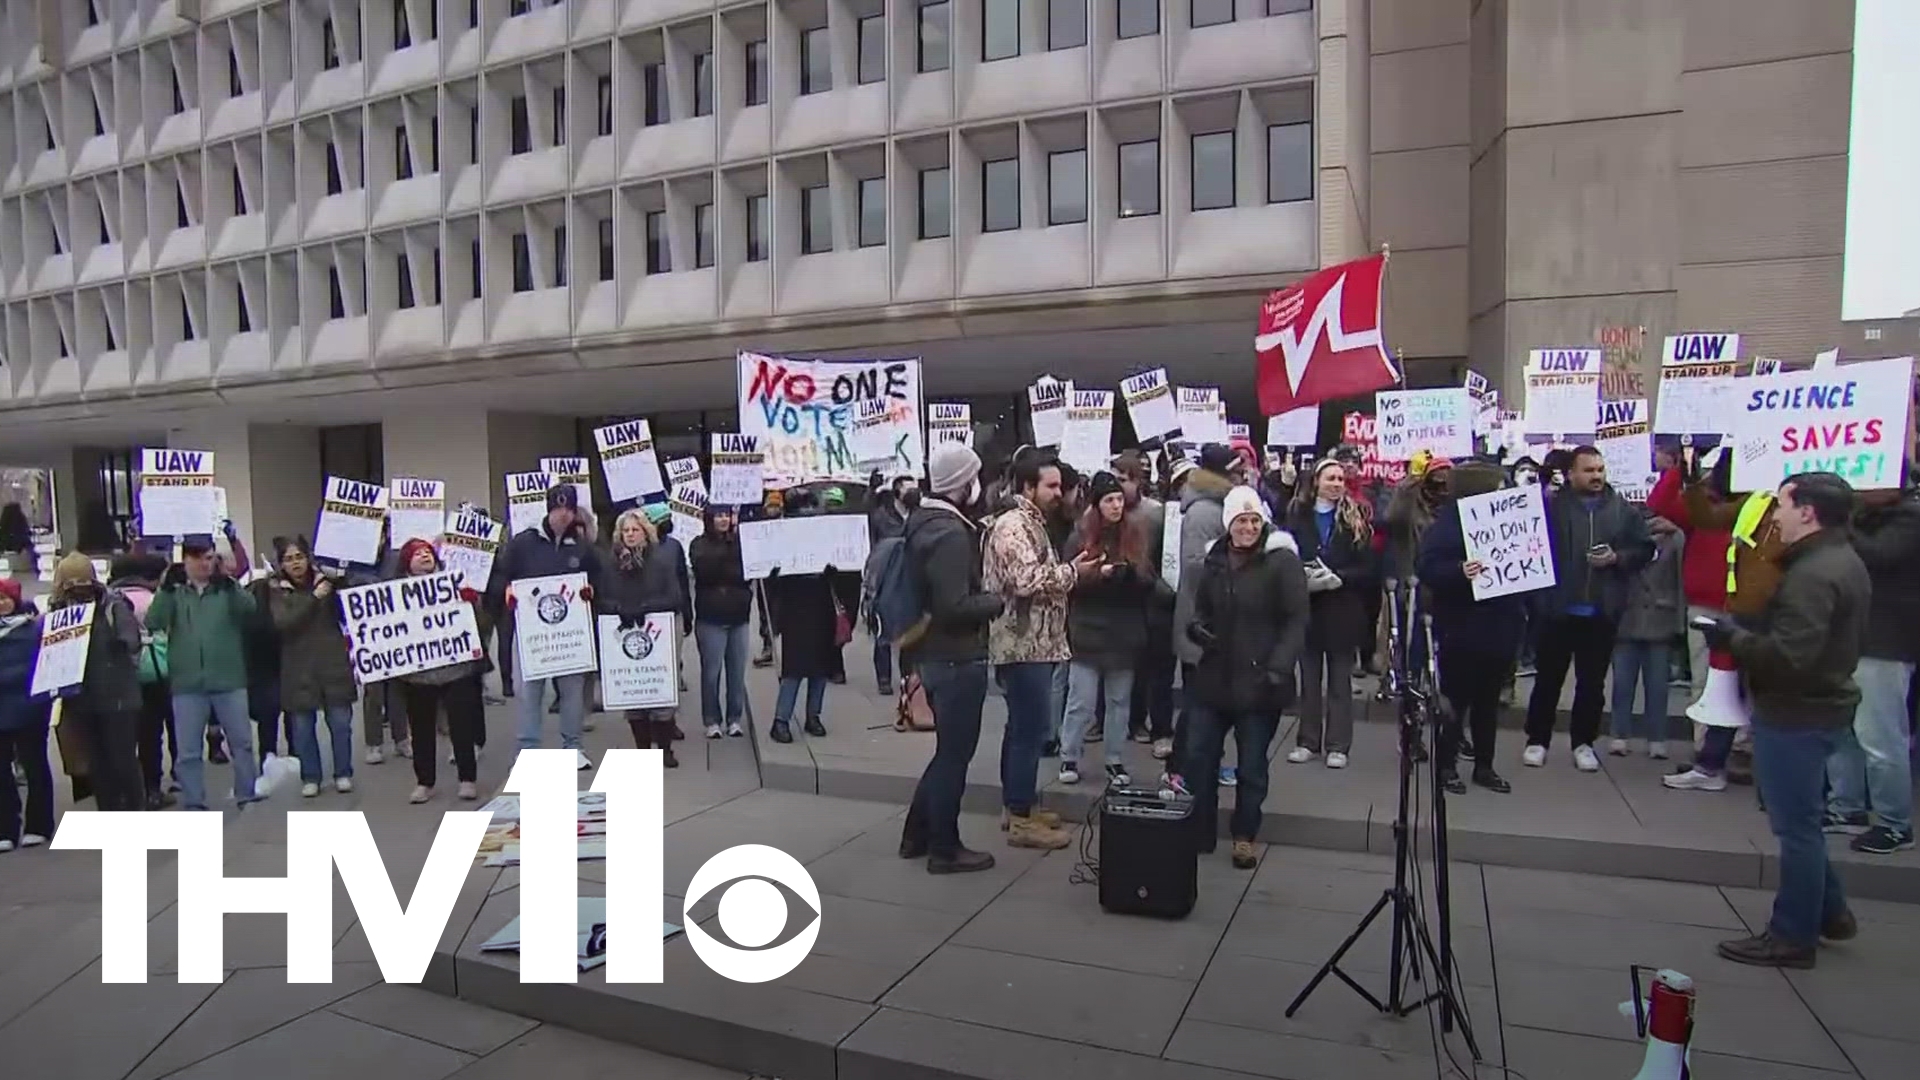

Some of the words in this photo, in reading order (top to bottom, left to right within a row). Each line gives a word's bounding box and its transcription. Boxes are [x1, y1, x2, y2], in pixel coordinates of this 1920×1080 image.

[1674, 336, 1726, 360] UAW
[1541, 351, 1589, 371] UAW
[748, 360, 817, 404] NO
[831, 363, 907, 404] ONE
[1128, 371, 1158, 393] UAW
[1531, 377, 1575, 387] STAND
[1578, 376, 1595, 385] UP
[1664, 368, 1708, 379] STAND
[1712, 365, 1731, 375] UP
[1036, 382, 1066, 400] UAW
[1074, 392, 1106, 407] UAW
[1184, 388, 1212, 402] UAW
[1747, 381, 1857, 411] SCIENCE
[760, 393, 854, 436] VOTE
[861, 399, 886, 417] UAW
[936, 406, 964, 418] UAW
[1380, 398, 1401, 410] NO
[603, 422, 640, 446] UAW
[721, 435, 757, 452] UAW
[1384, 433, 1401, 445] NO
[1596, 428, 1626, 440] TAND
[1781, 419, 1883, 452] SAVES
[155, 451, 202, 472] UAW
[825, 431, 912, 475] MK
[549, 460, 581, 474] UAW
[146, 478, 189, 487] STAND
[193, 478, 210, 486] UP
[337, 480, 380, 504] UAW
[400, 481, 436, 497] UAW
[516, 474, 550, 492] UAW
[679, 486, 709, 508] UAW
[1471, 508, 1477, 520] I
[1490, 494, 1528, 517] HOPE
[456, 515, 494, 538] UAW
[1479, 556, 1547, 589] SICK!
[348, 585, 394, 620] BAN
[401, 572, 464, 610] MUSK
[51, 604, 87, 631] UAW
[357, 622, 408, 644] from
[423, 610, 460, 629] our
[356, 631, 471, 674] Government
